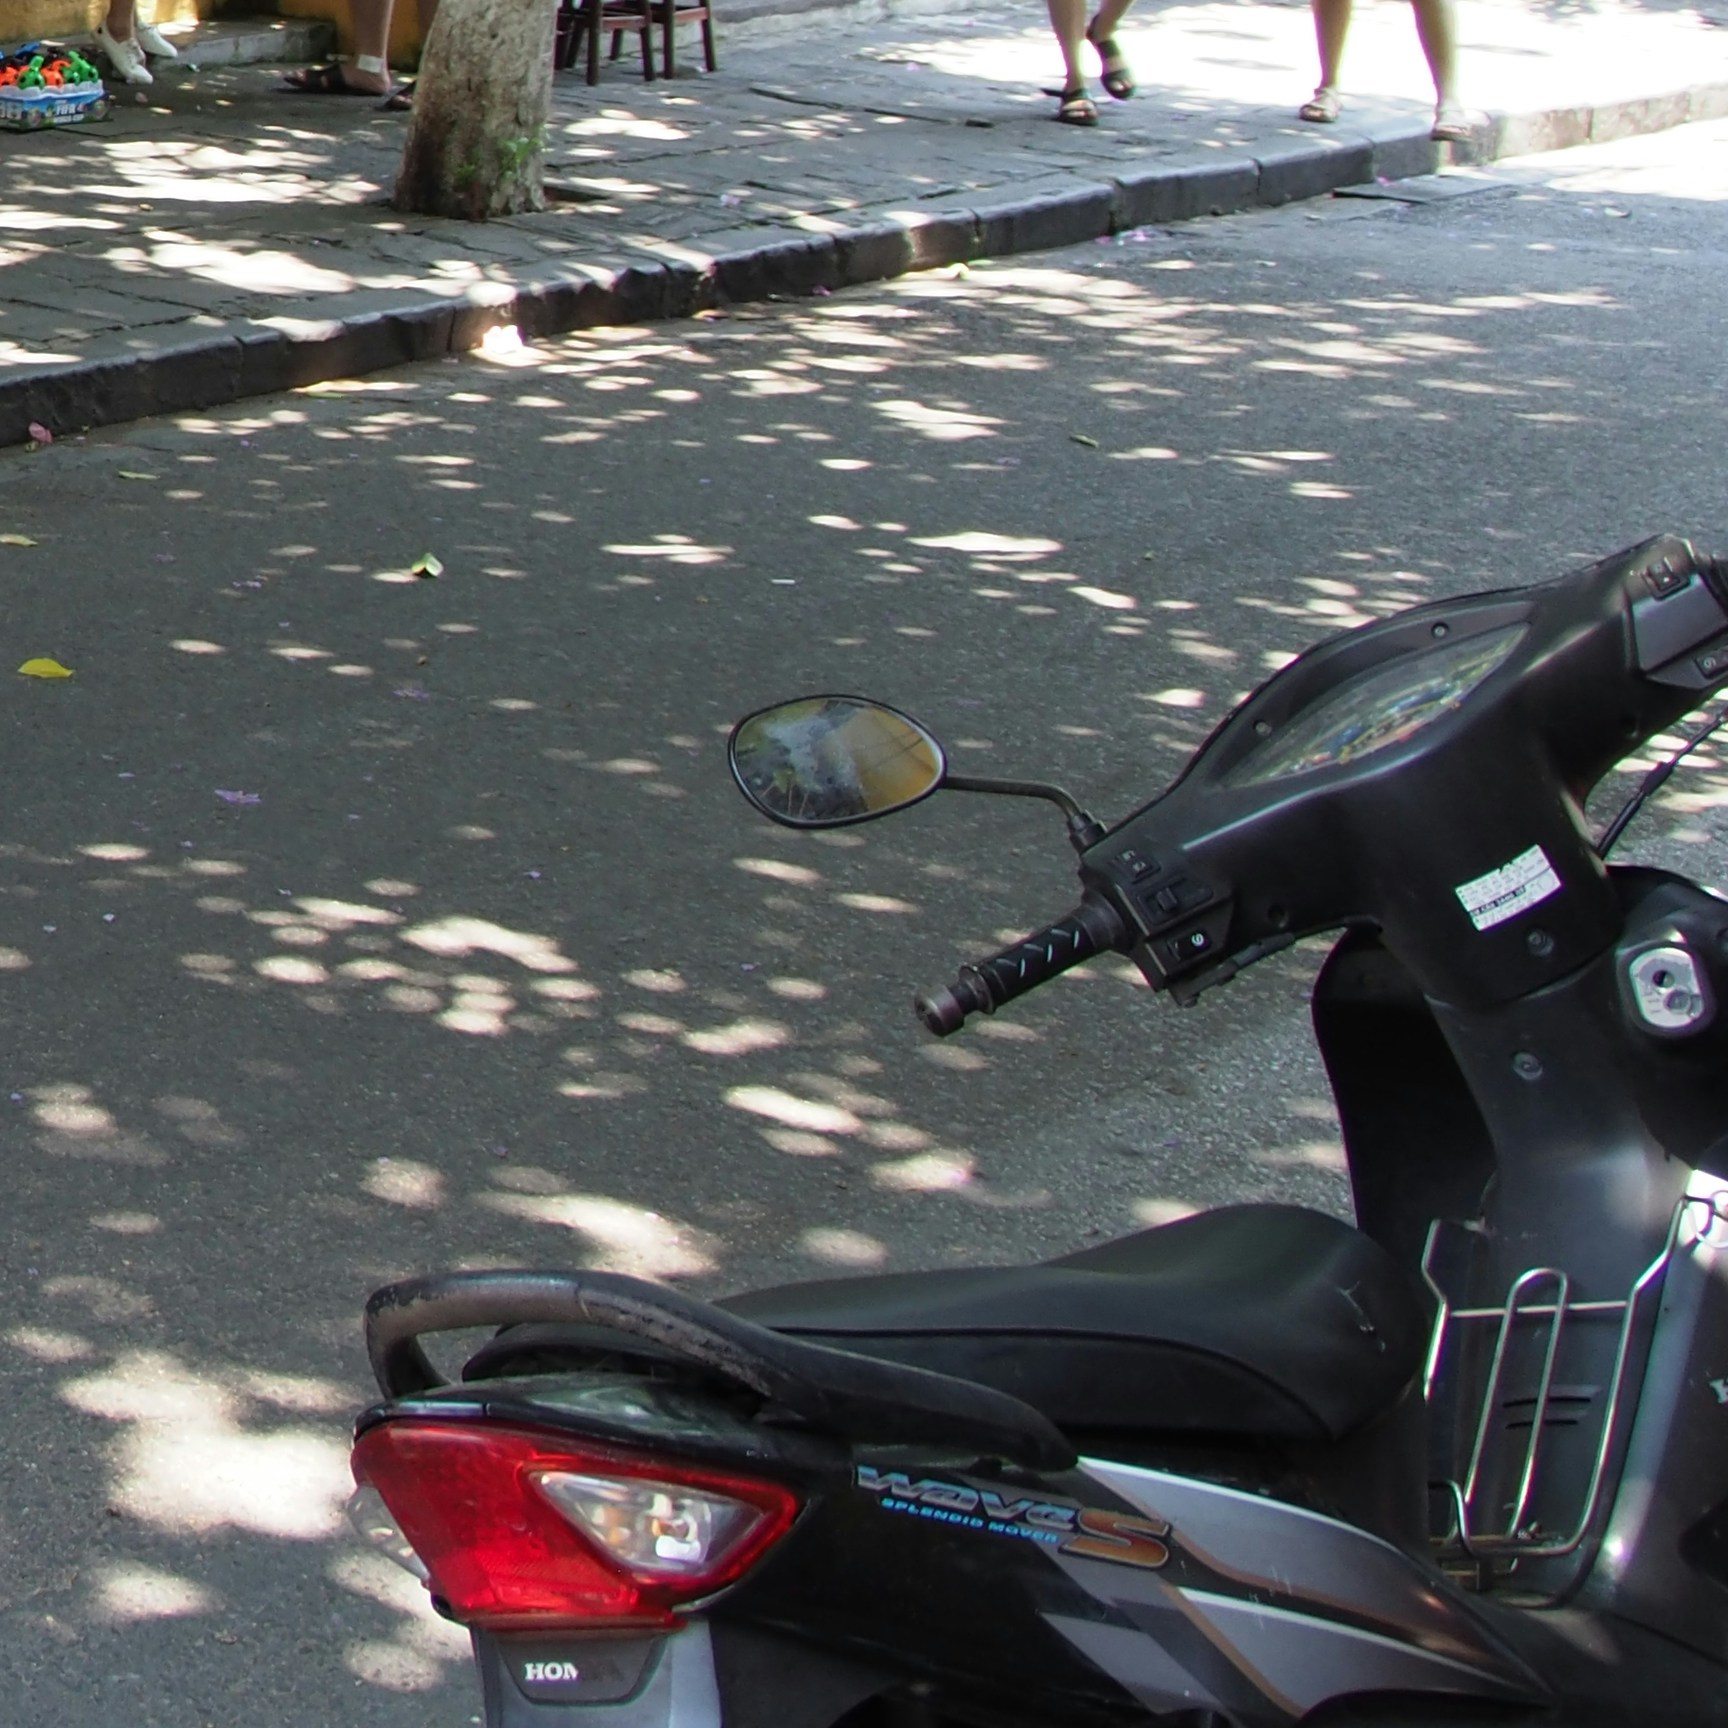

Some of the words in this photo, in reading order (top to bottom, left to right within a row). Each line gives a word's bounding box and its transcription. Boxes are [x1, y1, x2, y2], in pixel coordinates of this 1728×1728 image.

[880, 1497, 984, 1528] SPLENDID
[988, 1521, 1059, 1544] MOVER
[1058, 1506, 1172, 1570] S
